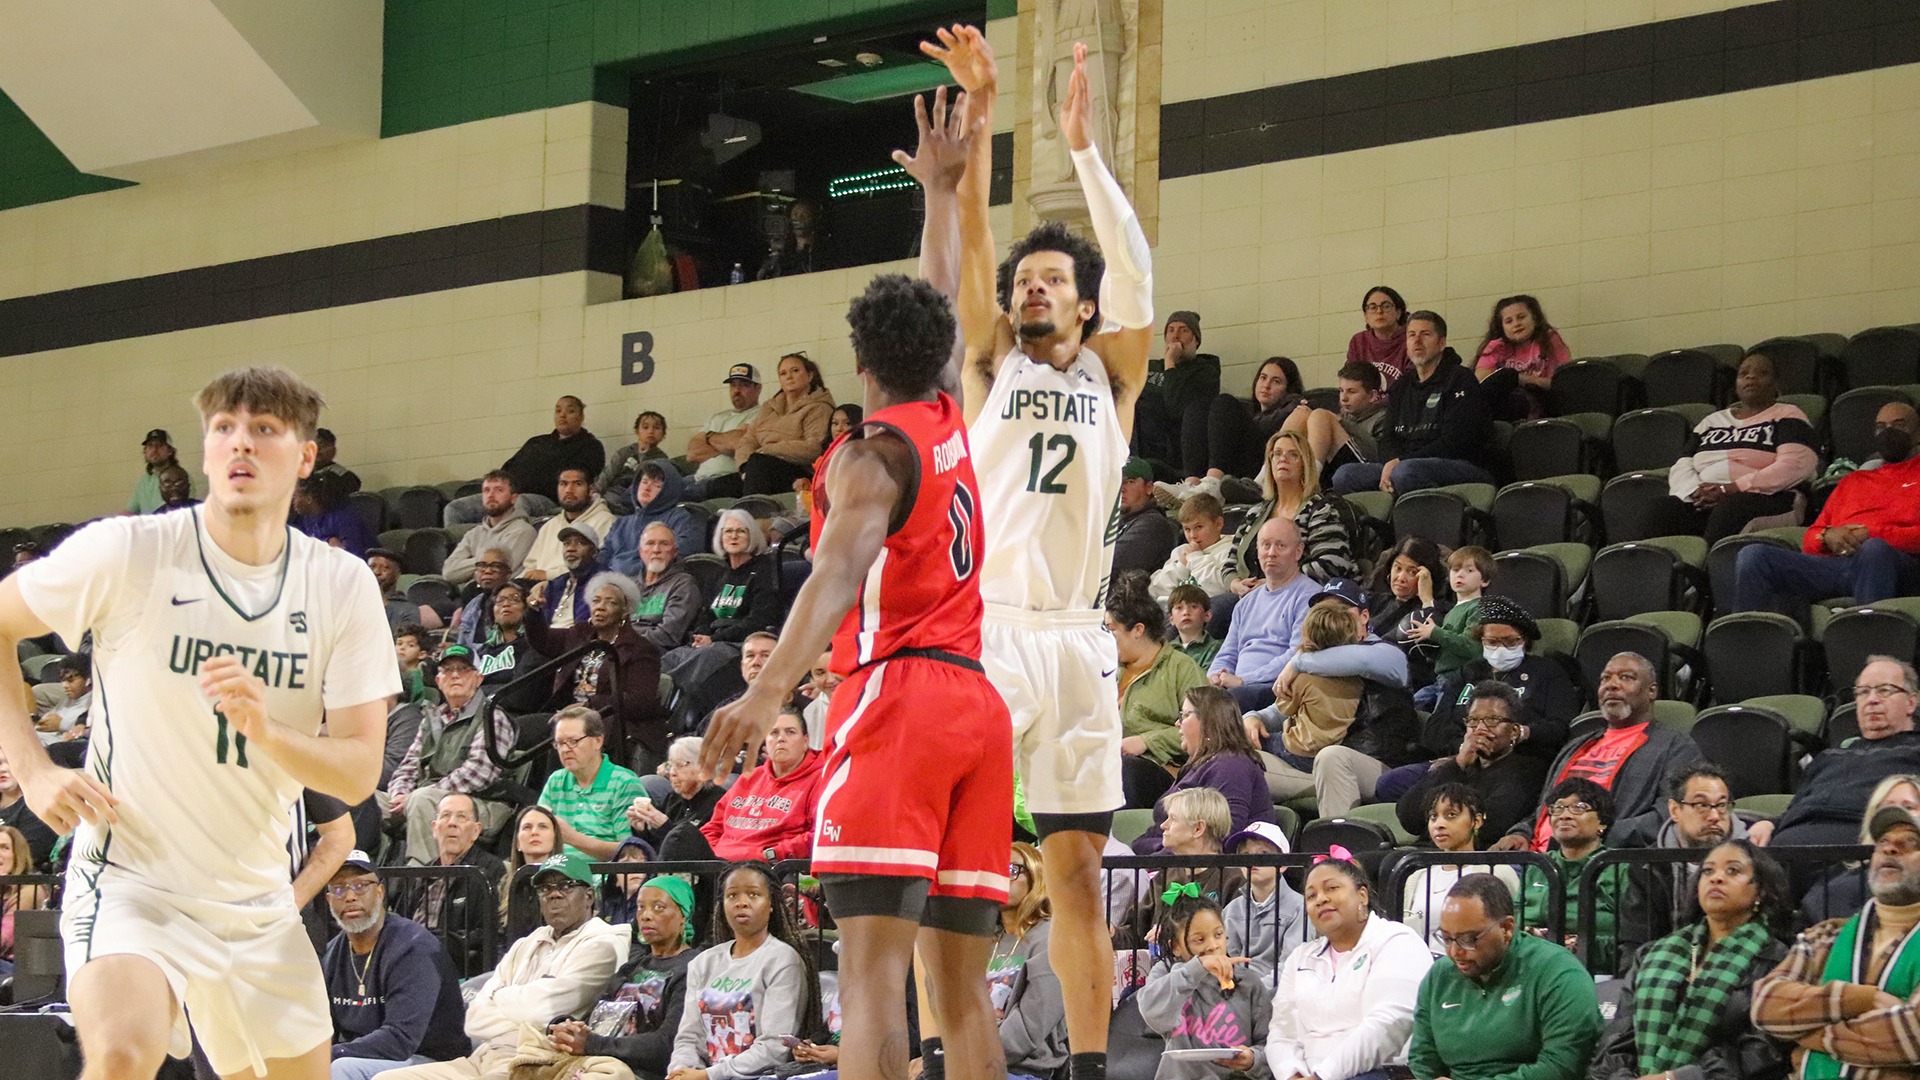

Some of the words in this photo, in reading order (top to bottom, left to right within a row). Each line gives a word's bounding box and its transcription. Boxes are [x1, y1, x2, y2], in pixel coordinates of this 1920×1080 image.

[621, 331, 654, 386] B
[1371, 362, 1403, 380] STATE
[1001, 389, 1098, 426] UPSTATE
[1026, 432, 1077, 494] 12
[948, 477, 974, 581] 0
[213, 700, 249, 769] 11
[823, 819, 842, 842] GW
